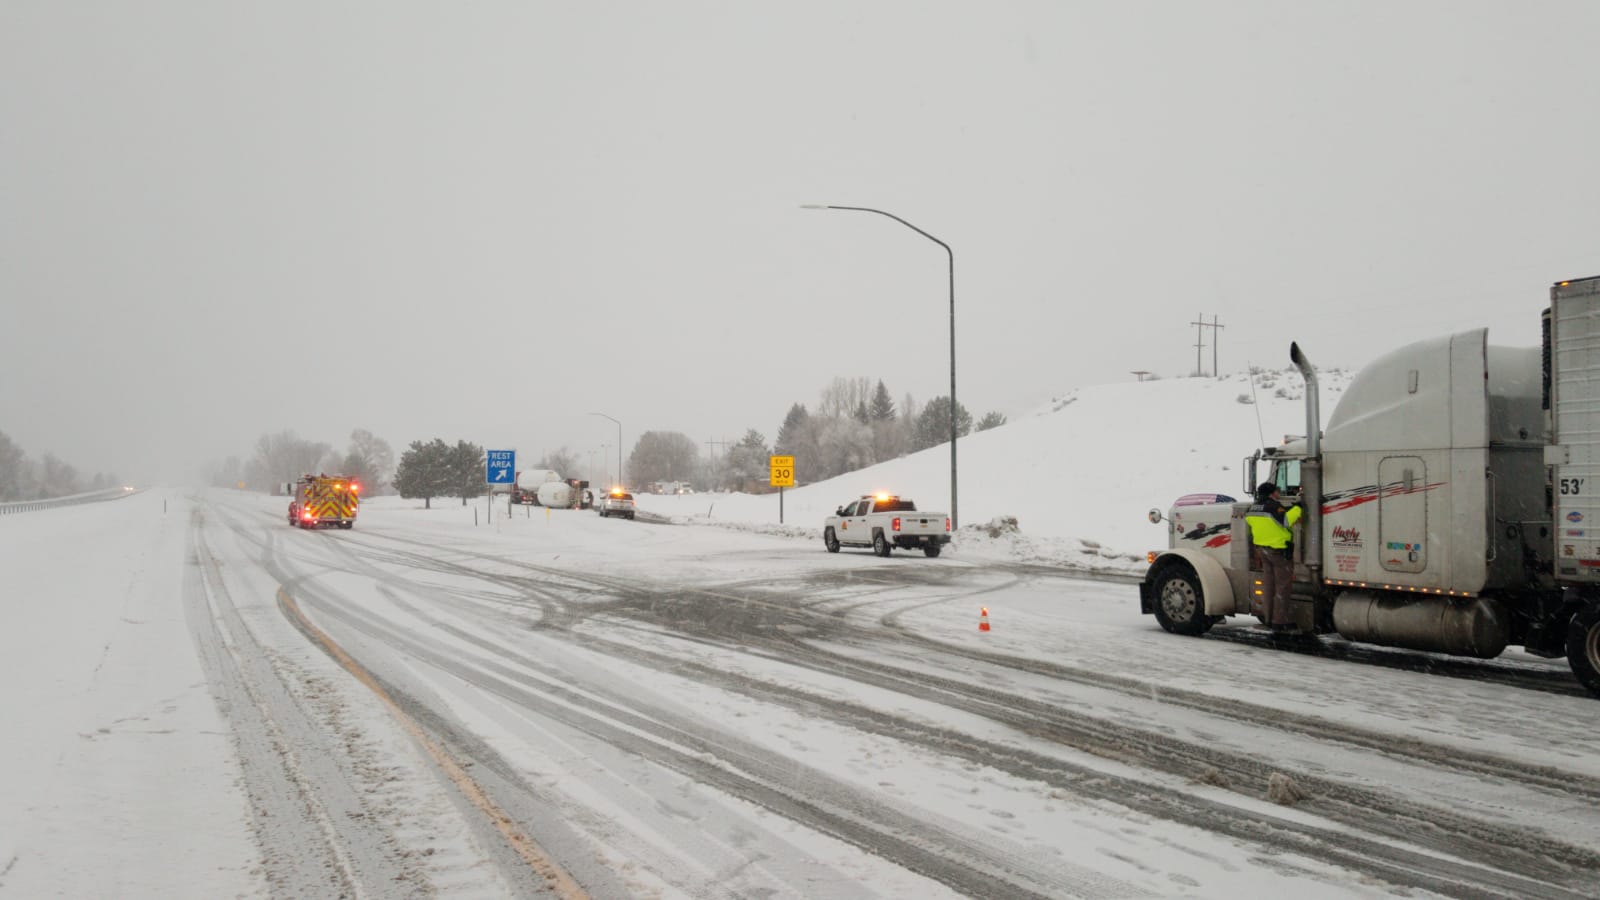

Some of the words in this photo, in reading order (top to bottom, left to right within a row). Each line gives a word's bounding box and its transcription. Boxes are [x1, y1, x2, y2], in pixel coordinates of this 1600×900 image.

[491, 452, 511, 460] REST
[775, 469, 790, 479] 30
[1560, 478, 1585, 495] 53'
